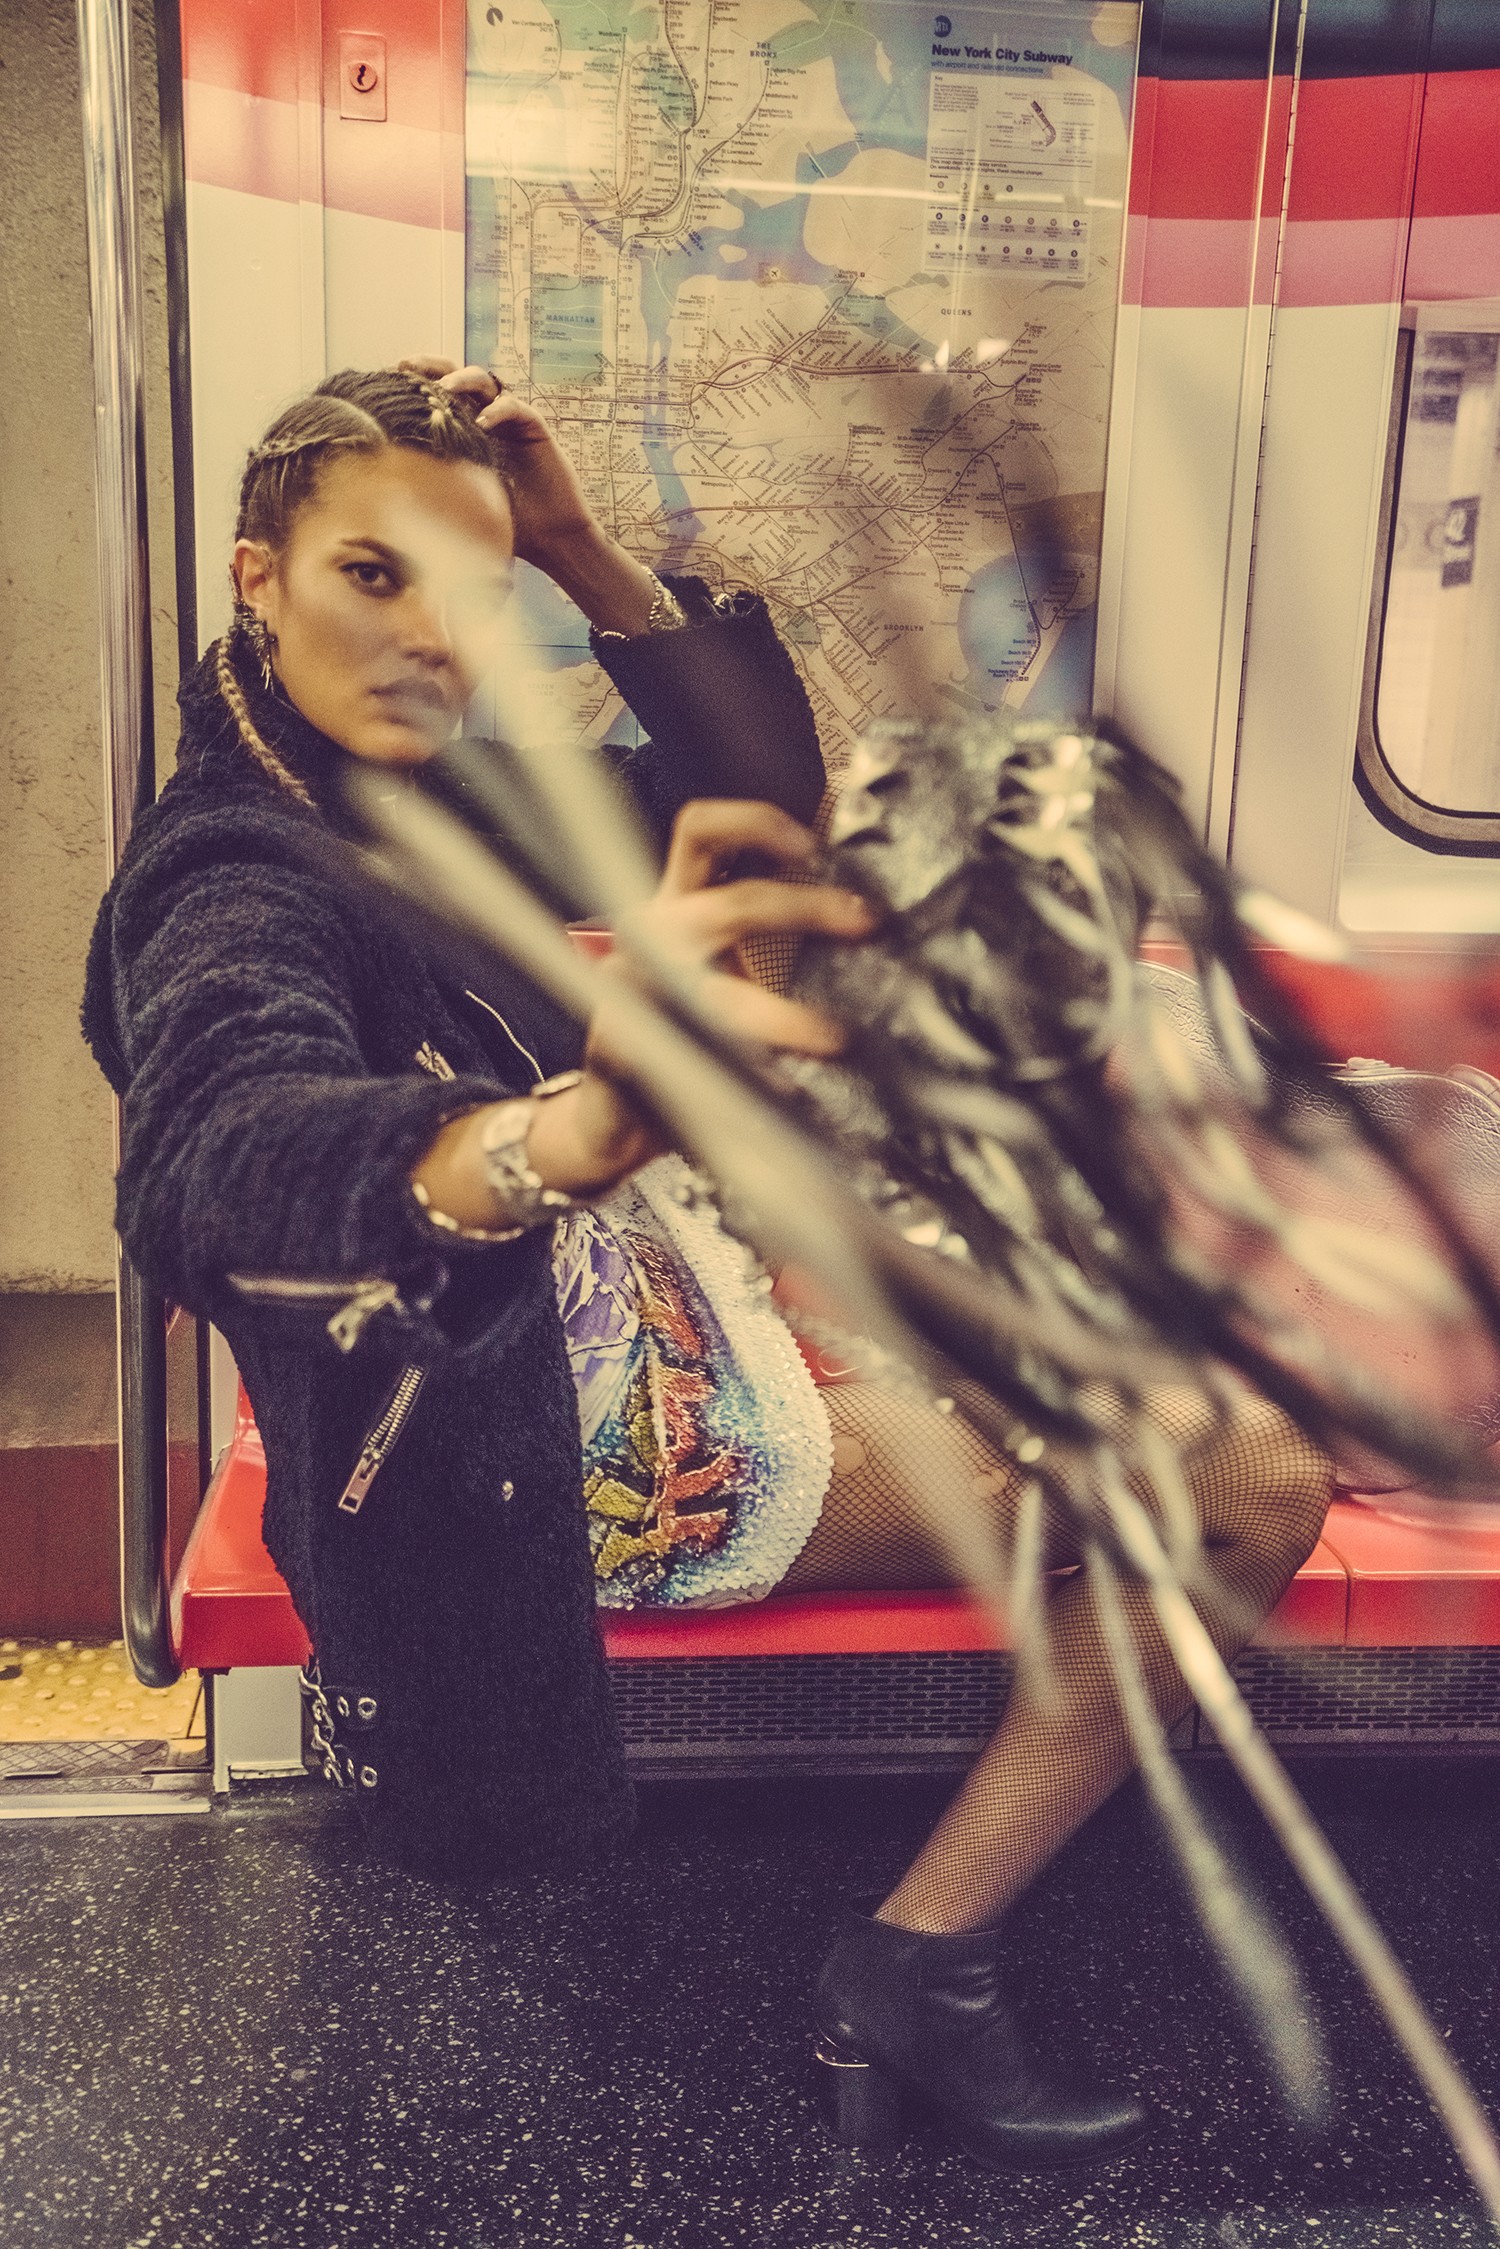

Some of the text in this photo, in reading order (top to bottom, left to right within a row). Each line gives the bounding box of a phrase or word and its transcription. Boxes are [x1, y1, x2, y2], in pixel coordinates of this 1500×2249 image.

[932, 44, 1073, 66] New York City Subway
[941, 308, 972, 316] QUEENS
[546, 314, 595, 324] MANHATTAN
